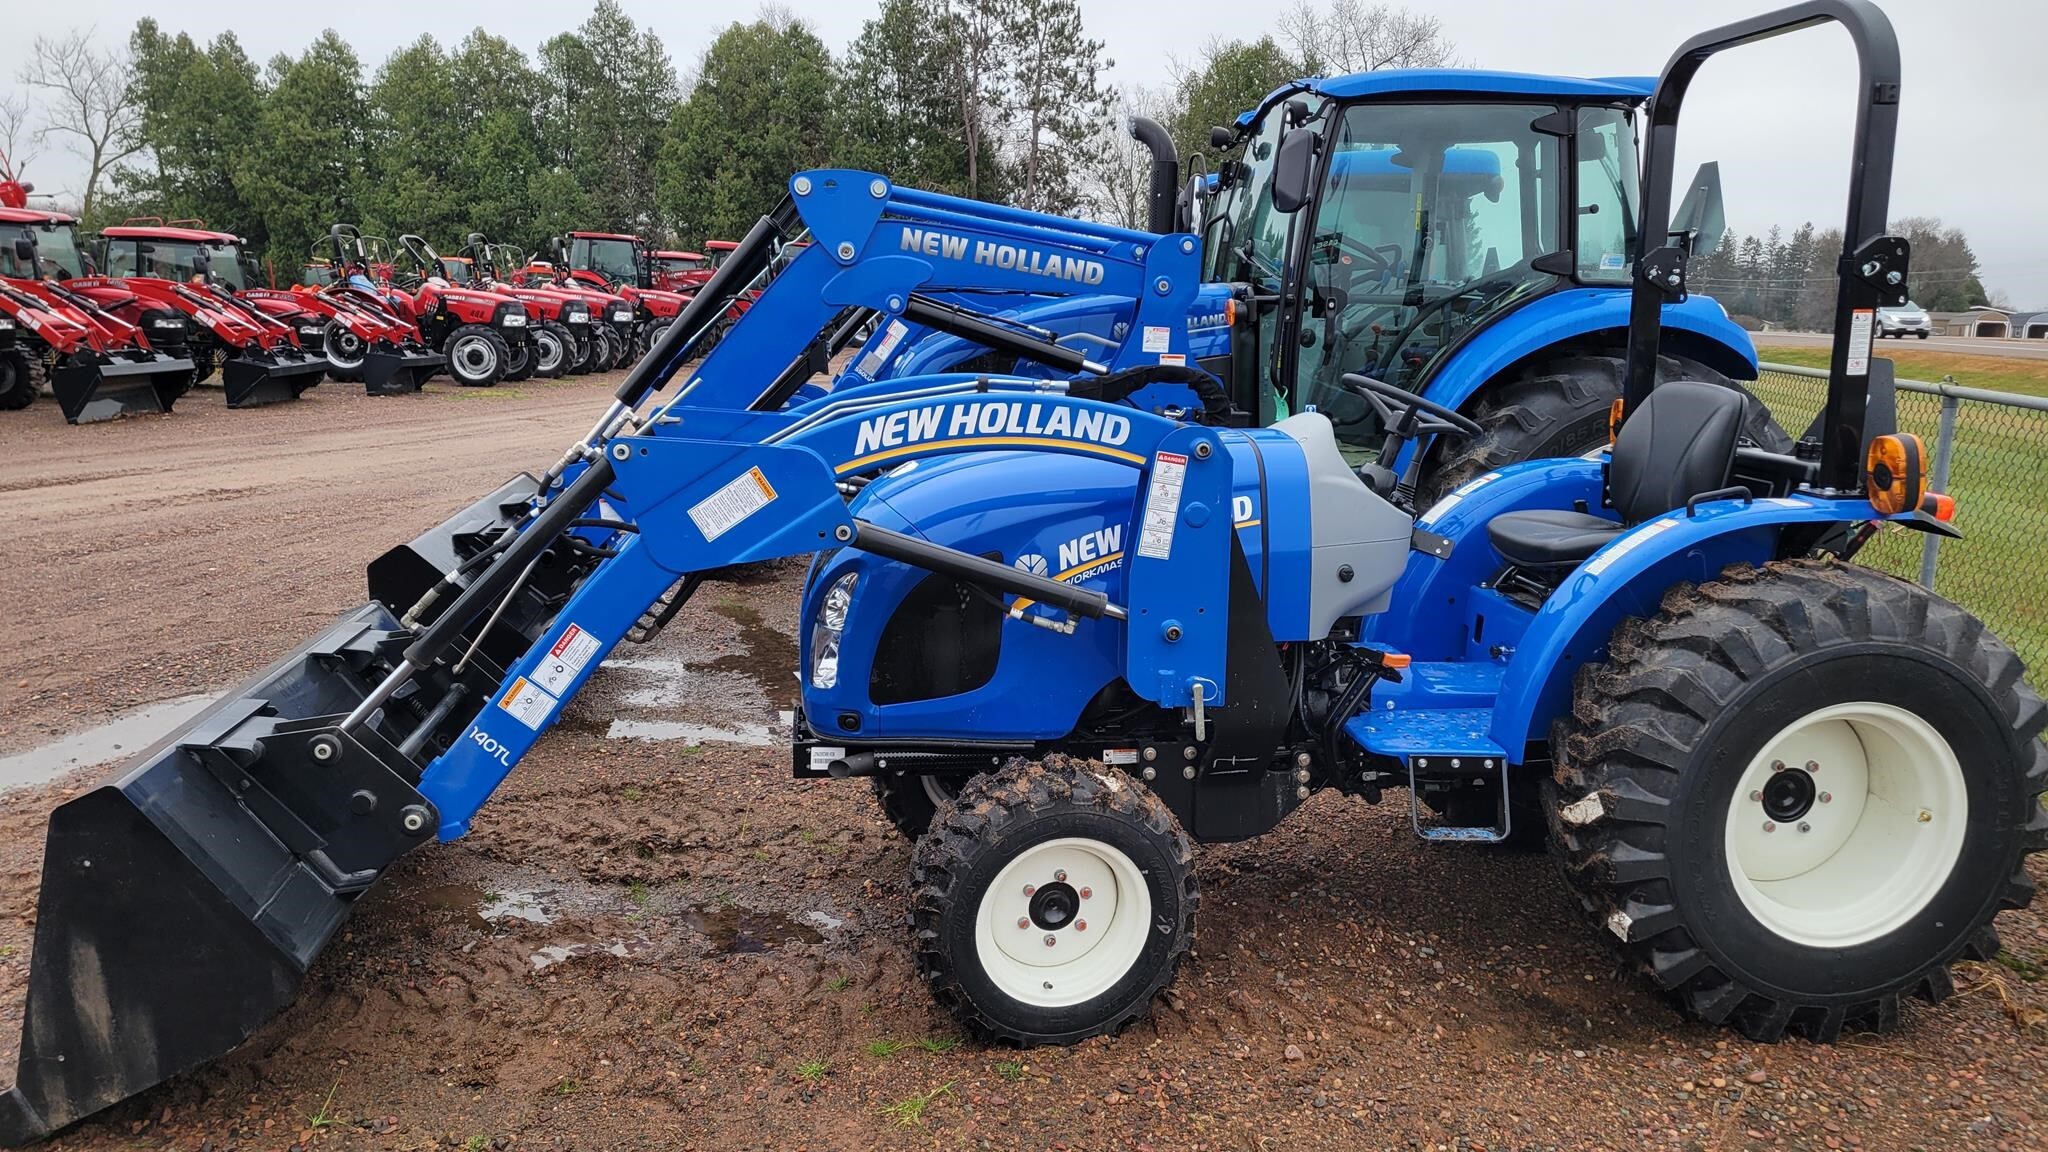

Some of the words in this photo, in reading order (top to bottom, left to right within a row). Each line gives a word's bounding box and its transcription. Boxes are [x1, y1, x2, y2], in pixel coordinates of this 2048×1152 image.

[900, 227, 968, 260] NEW
[974, 240, 1105, 285] HOLLAND
[1187, 313, 1226, 328] LLAND
[853, 404, 945, 456] NEW
[948, 402, 1131, 446] HOLLAND
[1058, 523, 1121, 571] NEW
[558, 627, 578, 650] DANGER
[468, 725, 510, 766] 140TL
